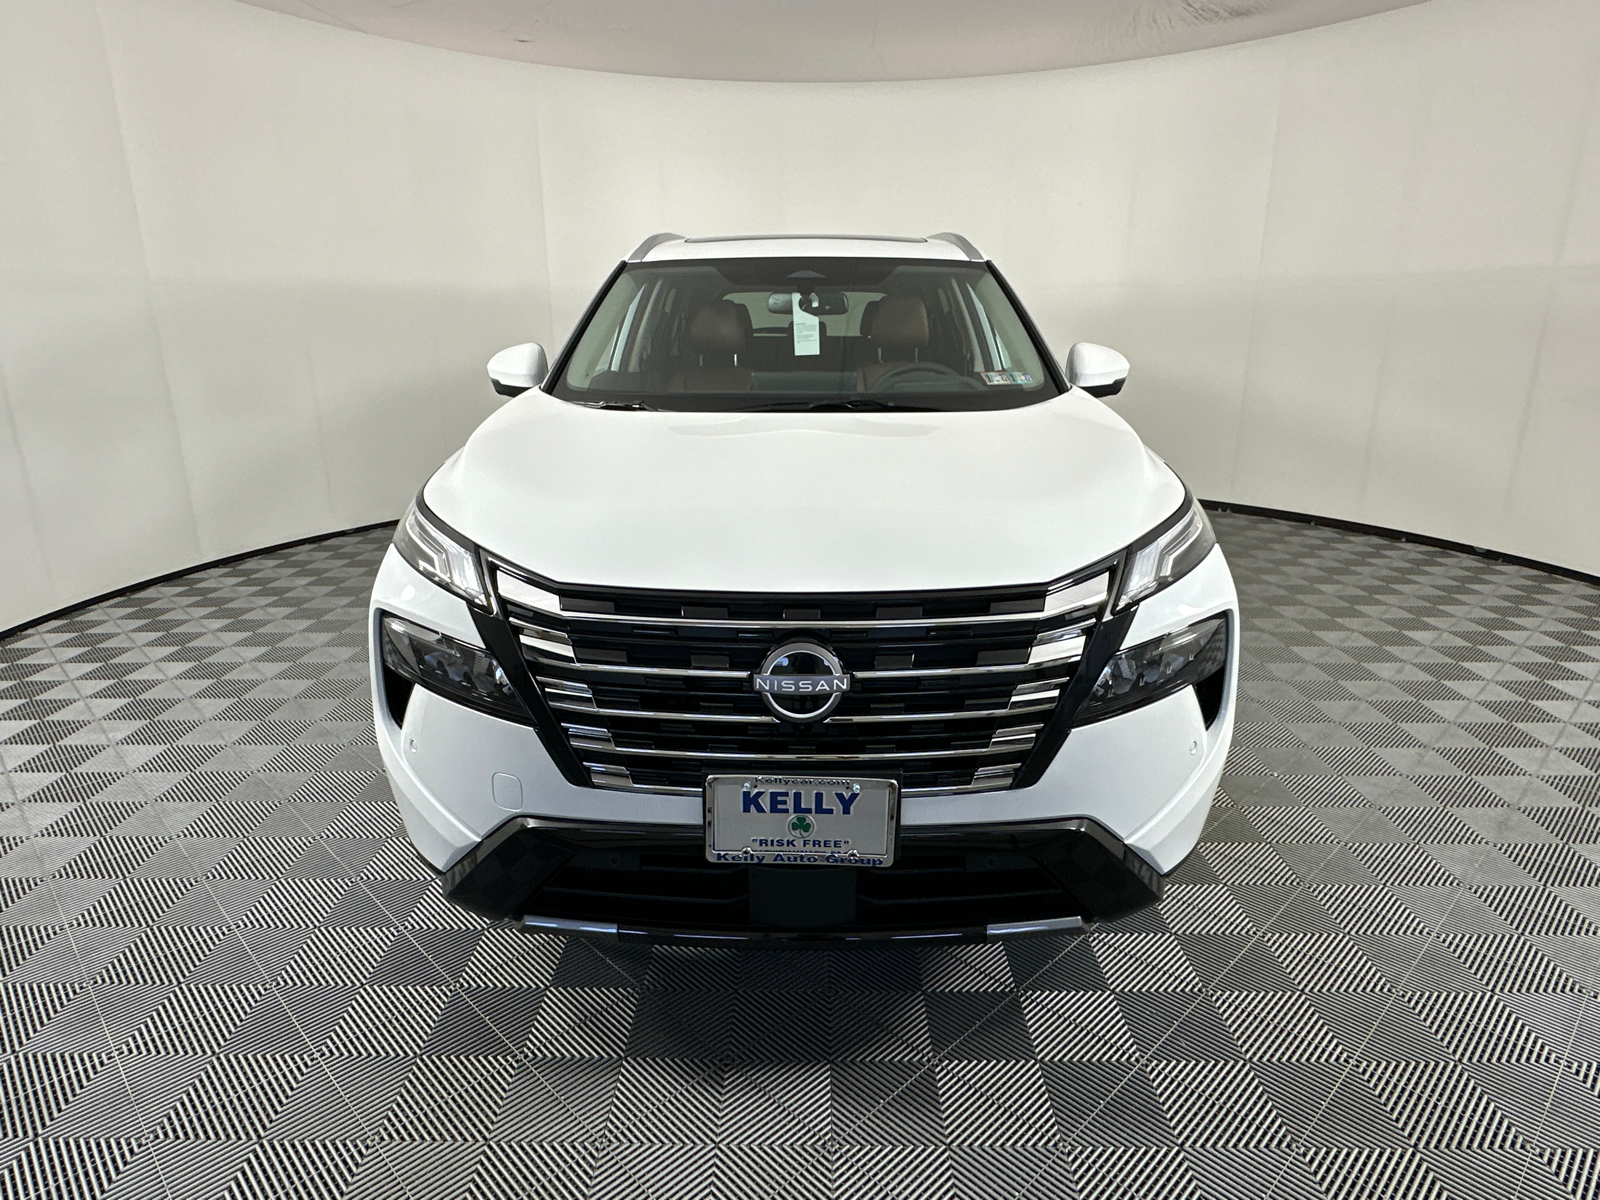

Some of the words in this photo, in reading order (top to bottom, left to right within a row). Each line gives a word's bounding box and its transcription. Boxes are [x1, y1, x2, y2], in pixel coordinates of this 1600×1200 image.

[756, 678, 847, 692] NISSAN
[754, 776, 850, 786] Kellycar.com
[742, 790, 860, 815] KELLY
[752, 838, 797, 848] "RISK
[803, 839, 850, 849] FREE"
[716, 852, 765, 865] Kelly
[773, 853, 818, 863] Auto
[825, 854, 883, 868] Group
